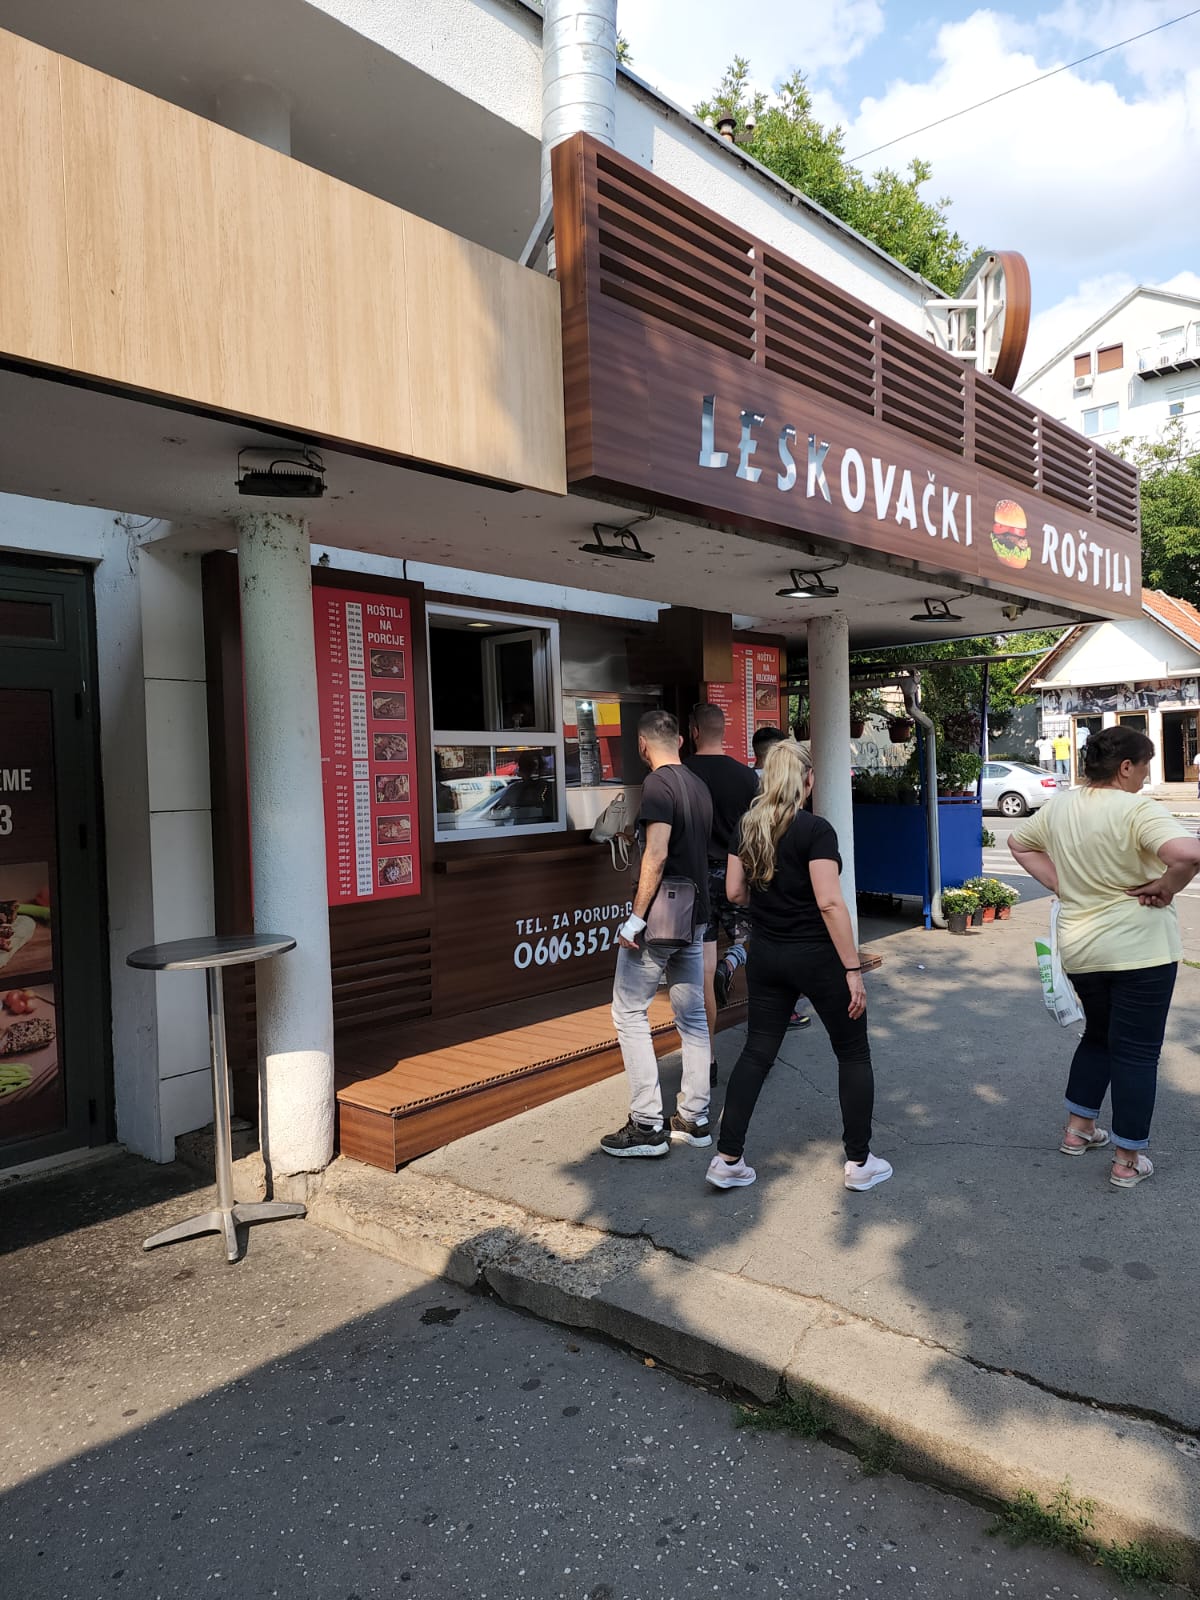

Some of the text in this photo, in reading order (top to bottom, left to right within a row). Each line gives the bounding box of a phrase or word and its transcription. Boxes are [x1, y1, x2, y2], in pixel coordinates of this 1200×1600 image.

[698, 394, 1132, 597] LESKOVAČKI ROŠTILJ
[367, 603, 404, 619] ROŠTILJ
[380, 619, 393, 631] NA
[367, 632, 405, 646] PORCIJE
[0, 769, 32, 791] ME
[515, 917, 548, 936] TEL.
[552, 912, 570, 930] ZA
